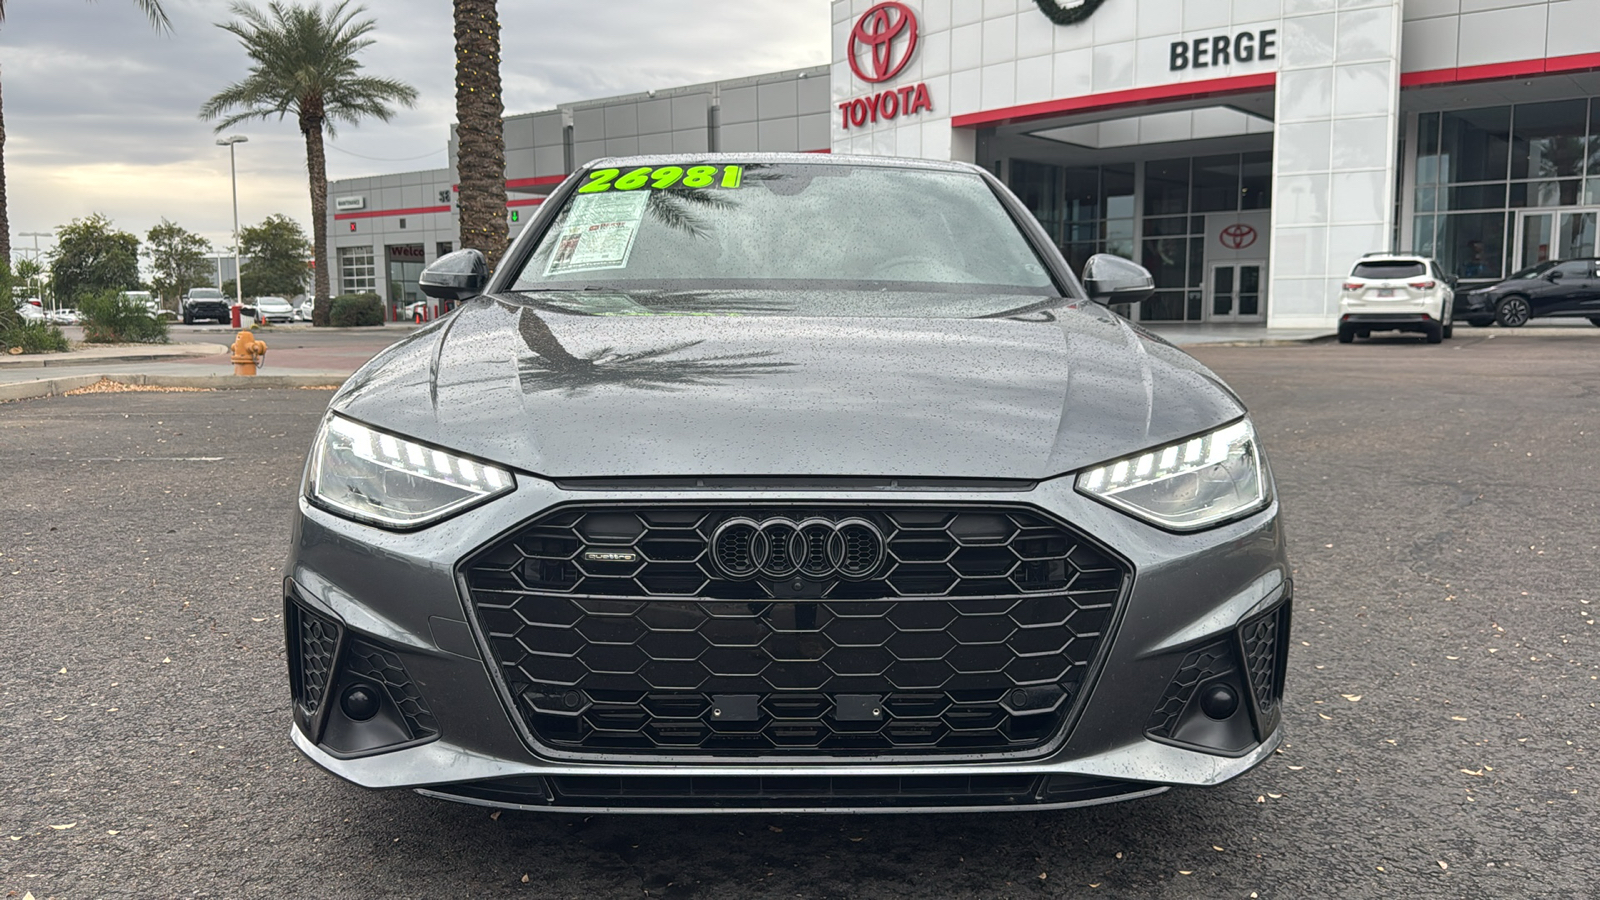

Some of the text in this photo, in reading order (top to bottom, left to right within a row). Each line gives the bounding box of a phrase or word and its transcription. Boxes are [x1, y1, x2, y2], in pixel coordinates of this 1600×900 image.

[1169, 29, 1277, 72] BERGE
[838, 83, 932, 130] TOYOTA
[577, 165, 742, 194] 26981
